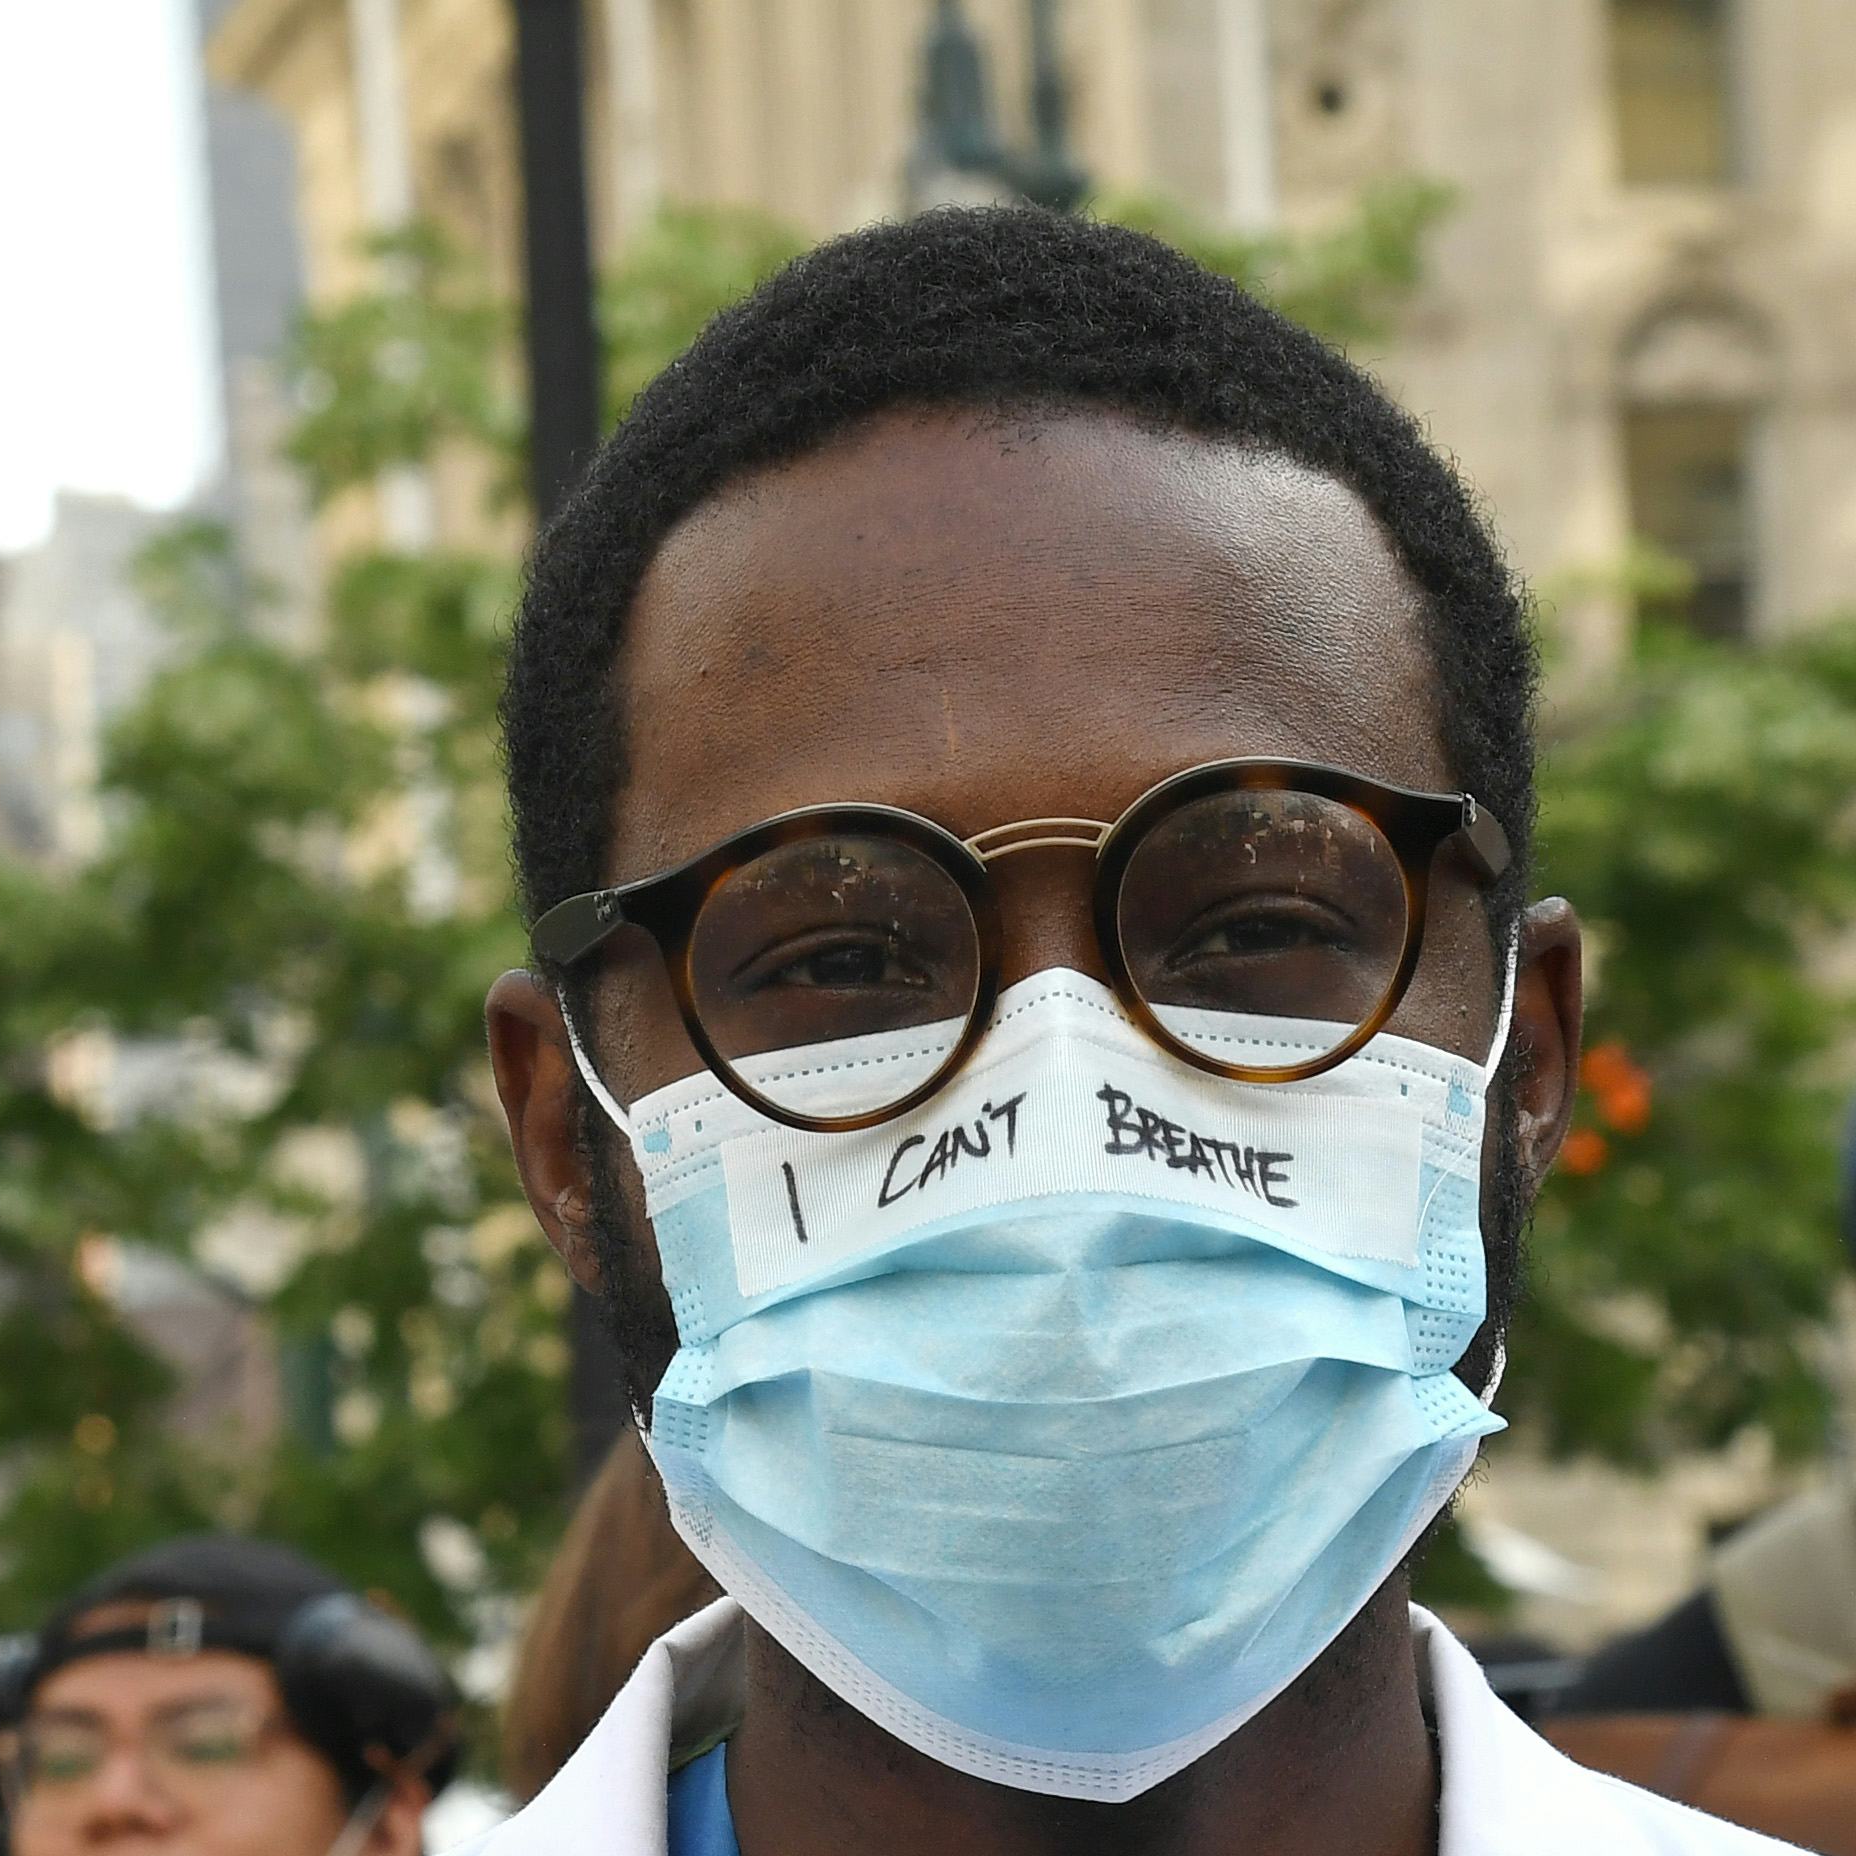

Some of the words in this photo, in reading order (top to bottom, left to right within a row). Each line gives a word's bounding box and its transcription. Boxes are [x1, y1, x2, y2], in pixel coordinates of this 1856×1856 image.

[782, 1162, 808, 1242] I
[876, 1094, 1028, 1209] CAN'T
[1097, 1081, 1301, 1209] BREATHE
